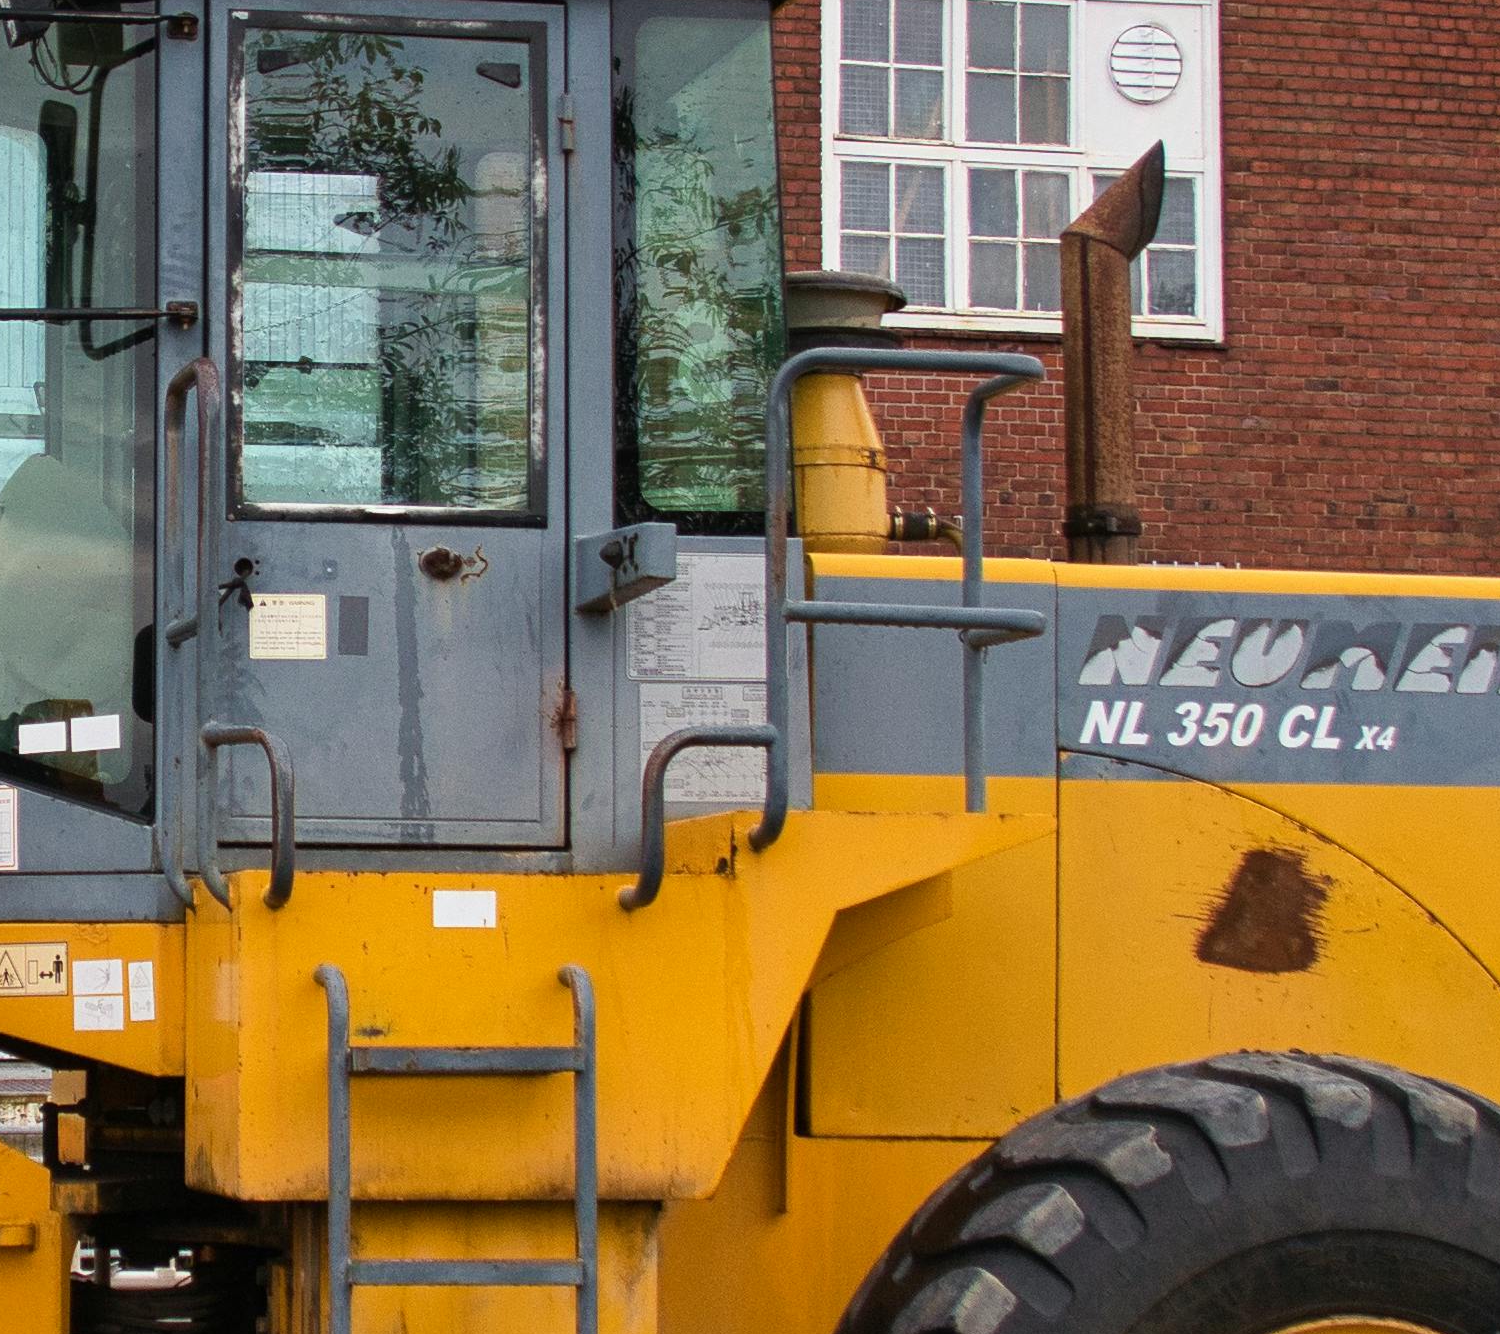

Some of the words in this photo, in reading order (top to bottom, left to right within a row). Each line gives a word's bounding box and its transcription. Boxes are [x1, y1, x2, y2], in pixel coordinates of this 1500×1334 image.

[1079, 700, 1149, 745] NL
[1167, 701, 1265, 747] 350
[1278, 705, 1343, 750] CL
